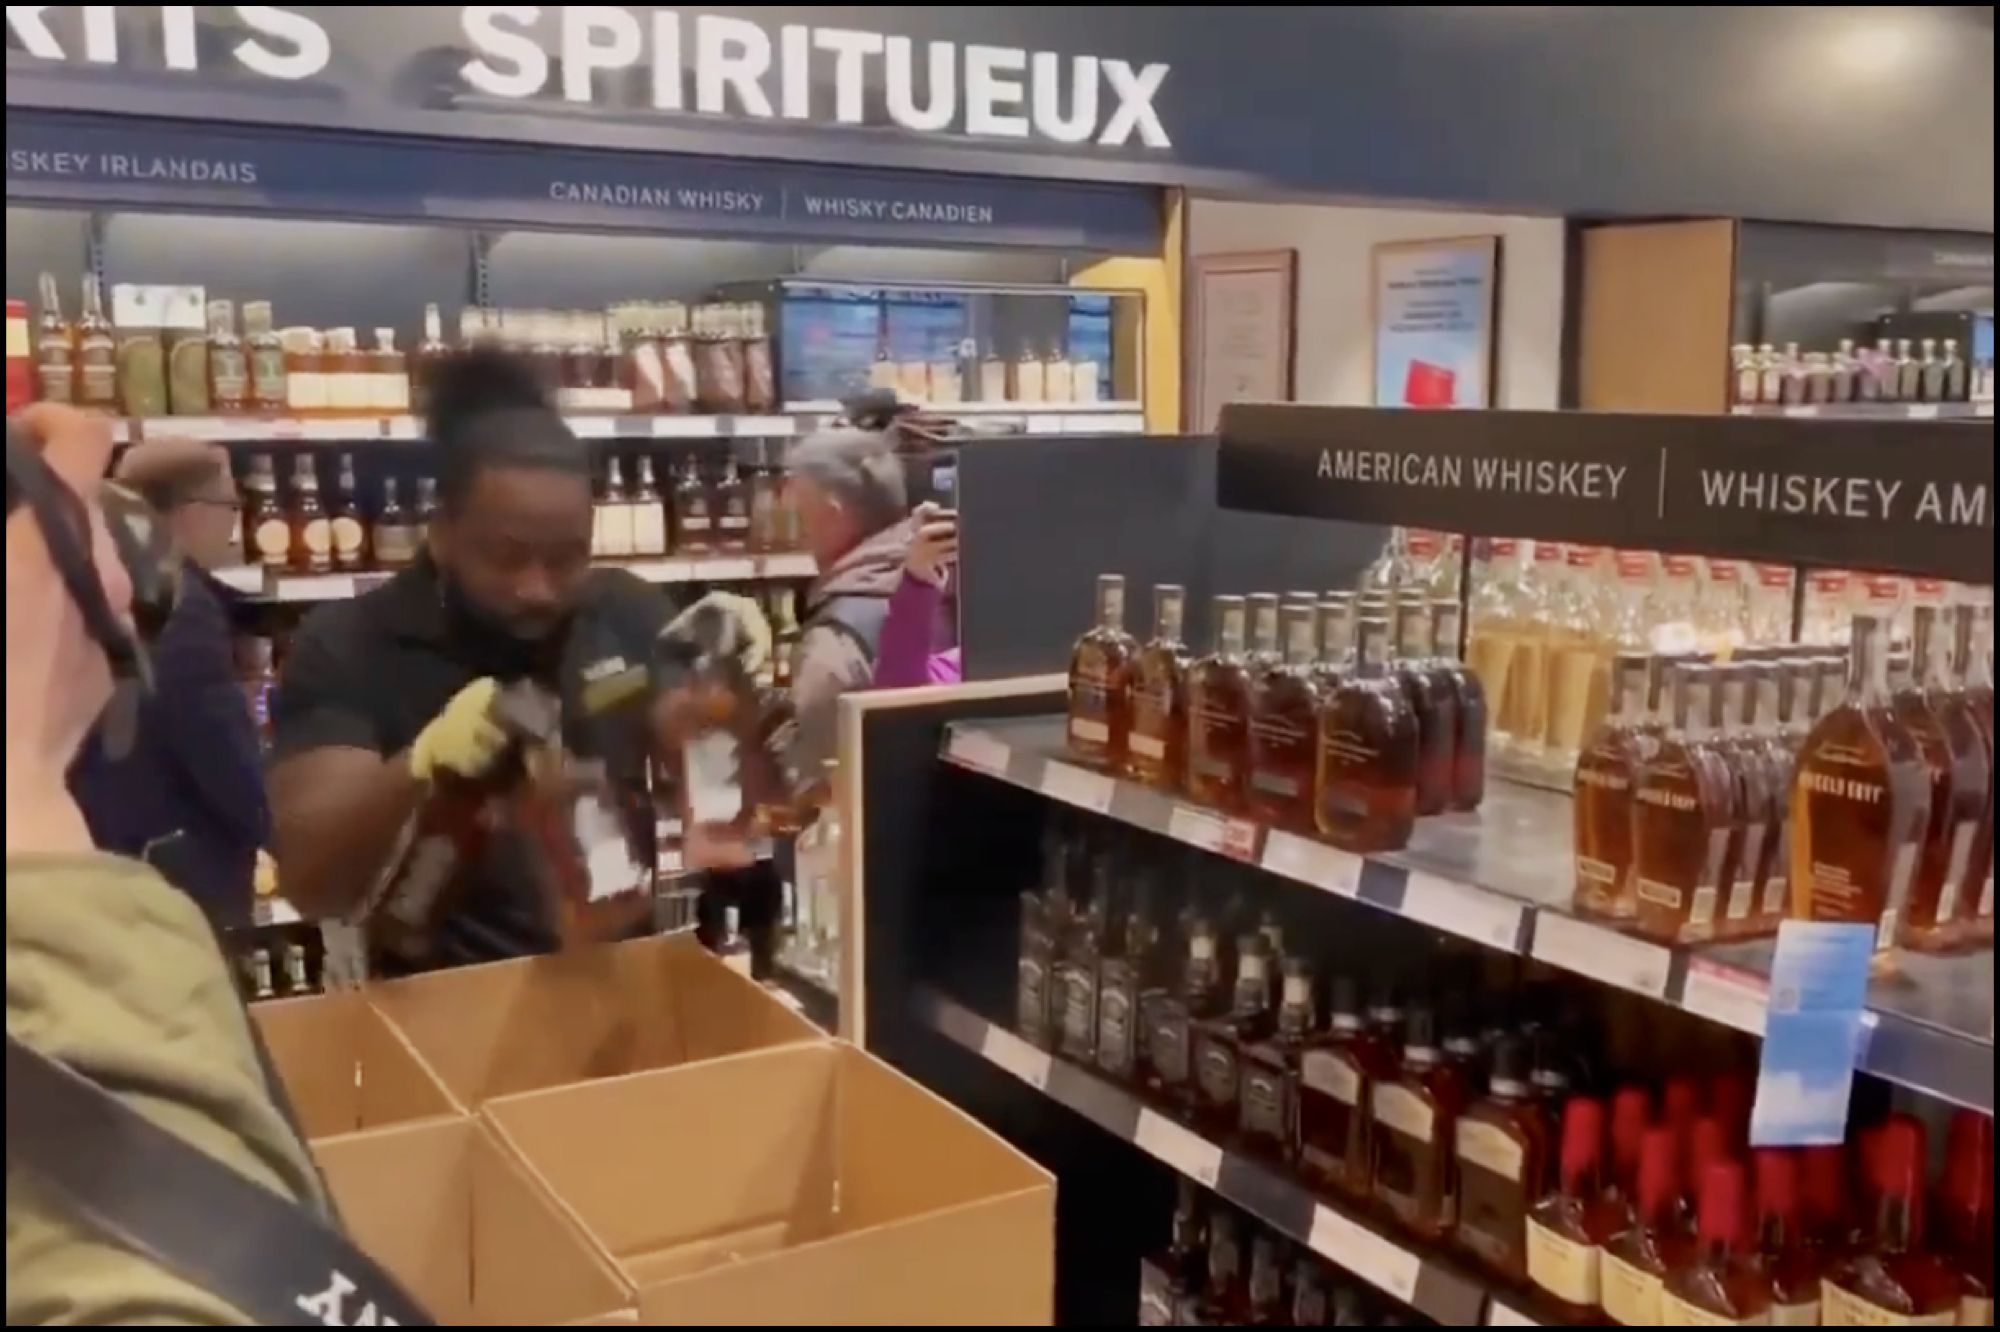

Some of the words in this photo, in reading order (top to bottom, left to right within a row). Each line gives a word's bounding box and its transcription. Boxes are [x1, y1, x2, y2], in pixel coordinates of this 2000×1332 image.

[459, 6, 1172, 147] SPIRITUEUX
[6, 149, 91, 175] SKEY
[101, 153, 258, 184] IRLANDAIS
[549, 181, 671, 207] CANADIAN
[676, 188, 764, 212] WHISKY
[804, 195, 886, 219] WHISKY
[890, 200, 993, 224] CANADIEN
[1317, 447, 1462, 488] AMERICAN
[1472, 456, 1627, 499] WHISKEY
[1700, 468, 1903, 520] WHISKEY
[1914, 480, 1994, 526] AM
